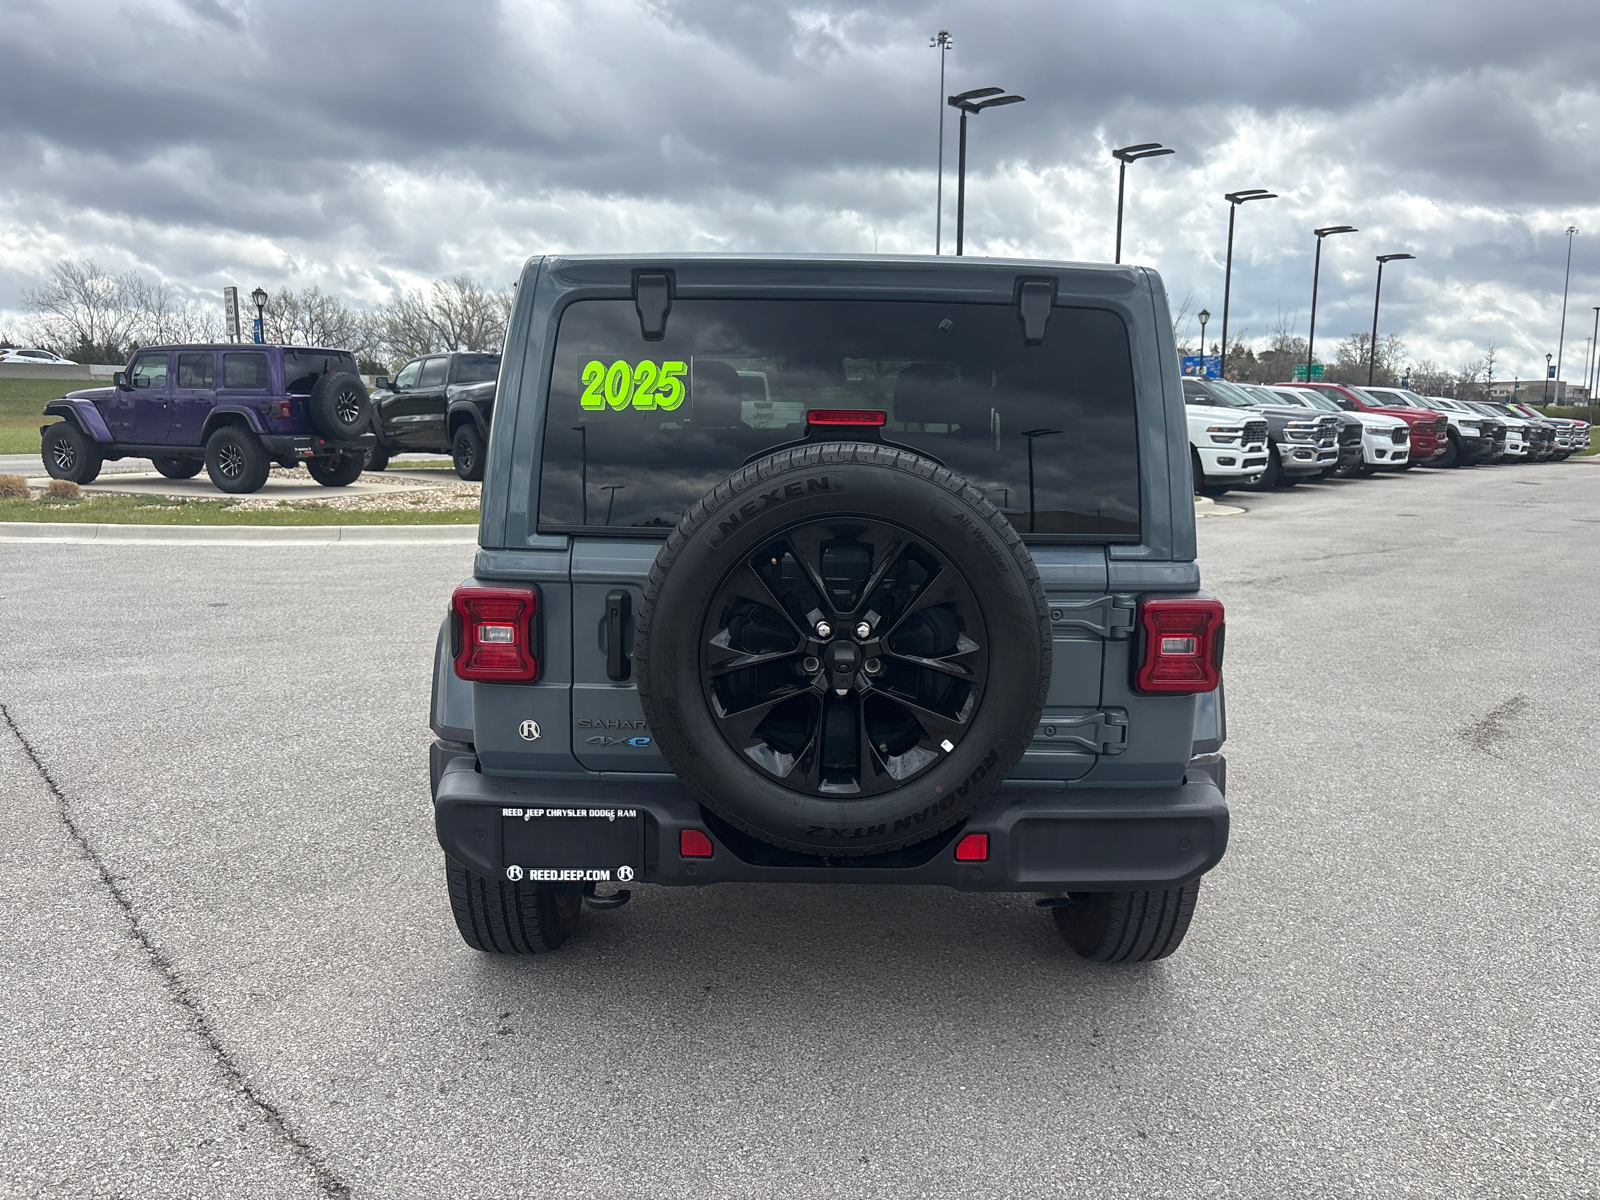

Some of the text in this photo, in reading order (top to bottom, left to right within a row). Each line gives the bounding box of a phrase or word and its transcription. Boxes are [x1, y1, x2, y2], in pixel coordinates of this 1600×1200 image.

[226, 306, 233, 314] 60
[580, 359, 688, 411] 2025
[718, 477, 830, 535] NEXEN
[953, 513, 1010, 573] All-Weather
[577, 718, 650, 730] SAHAR
[805, 748, 999, 840] ROADIAN HTX2
[502, 808, 637, 818] REED JEEP CHRYSLER DODGE RAM
[530, 869, 610, 881] REEDJEEP.COM
